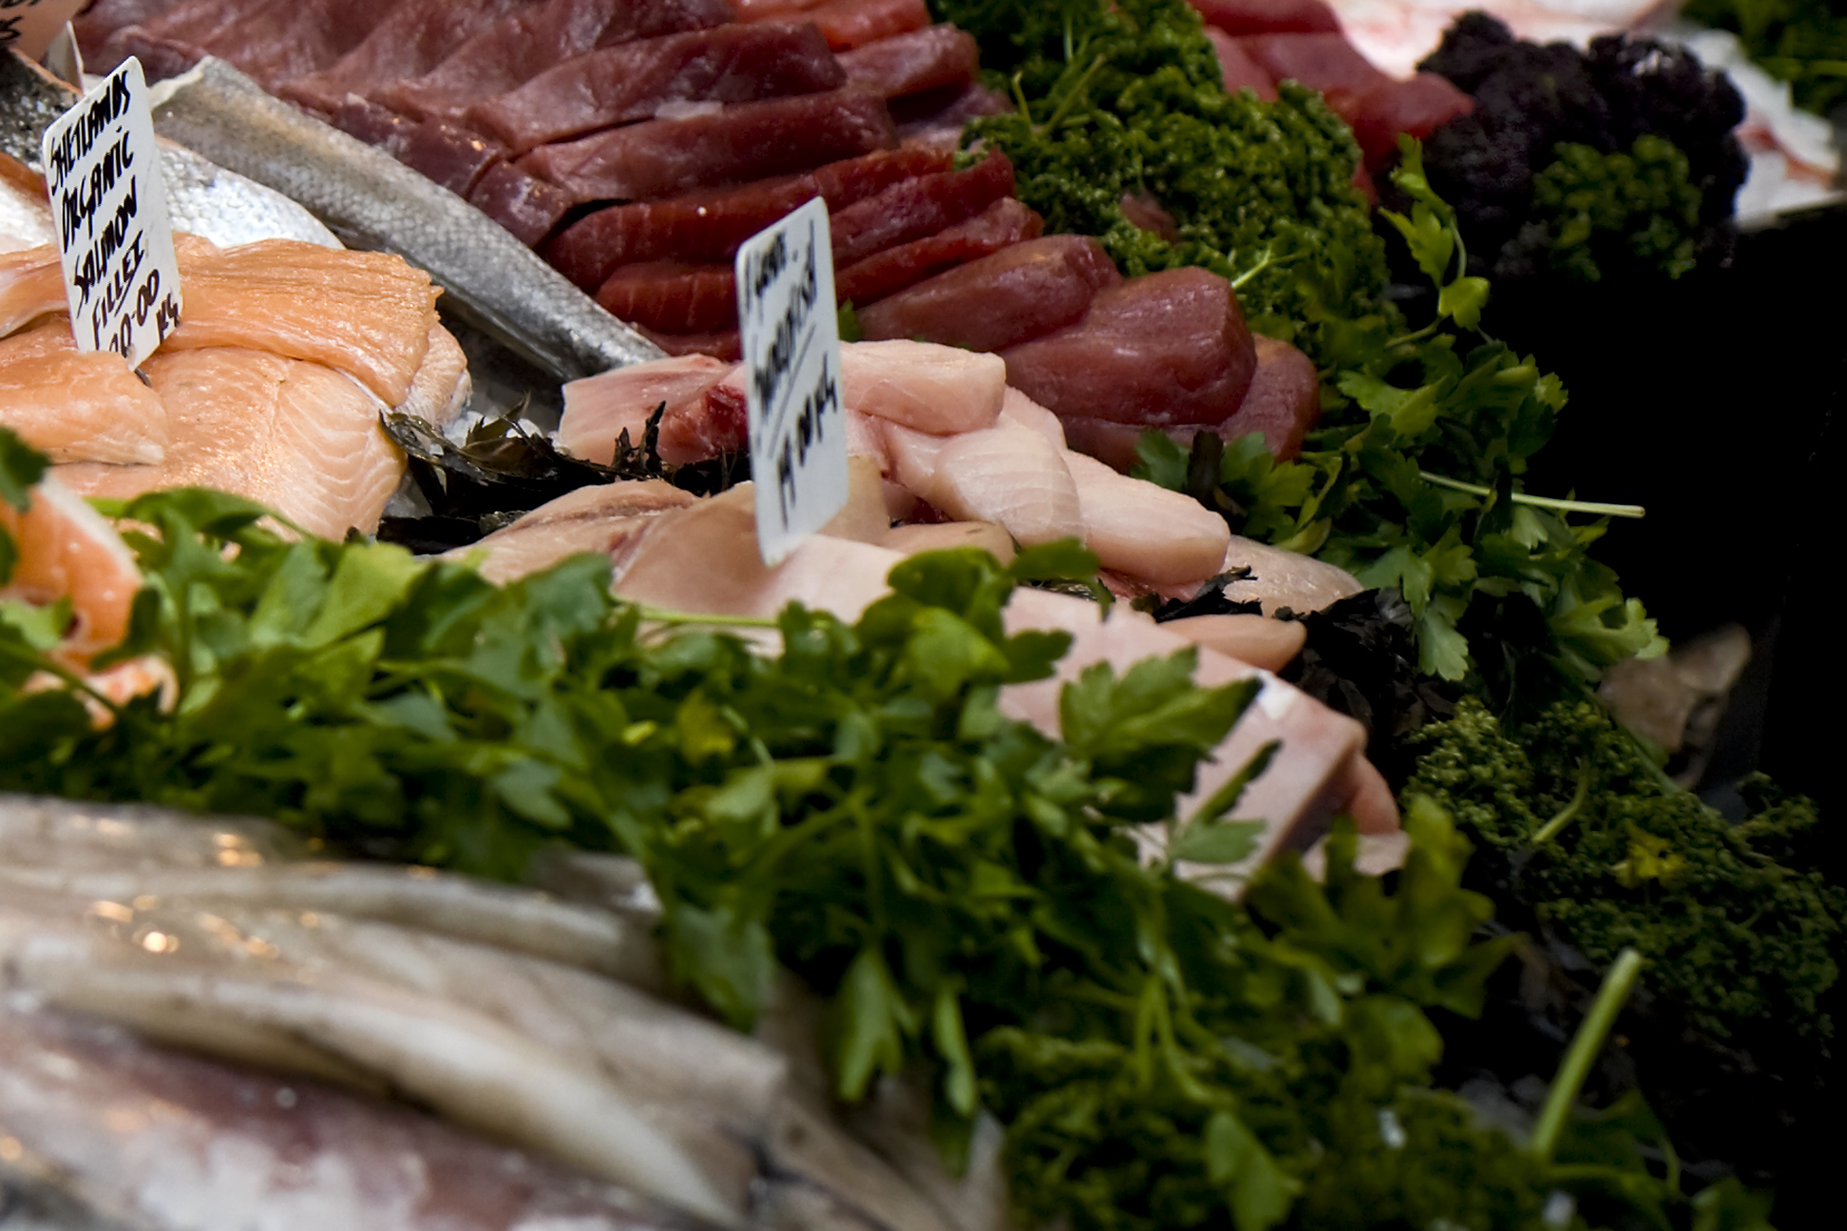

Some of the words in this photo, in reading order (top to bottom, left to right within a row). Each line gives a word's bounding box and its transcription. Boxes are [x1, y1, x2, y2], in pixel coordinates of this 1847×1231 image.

[50, 70, 131, 196] SHETLANDS
[62, 126, 134, 254] ORGANIC
[73, 174, 137, 319] SALMON
[92, 230, 145, 350] FILLET
